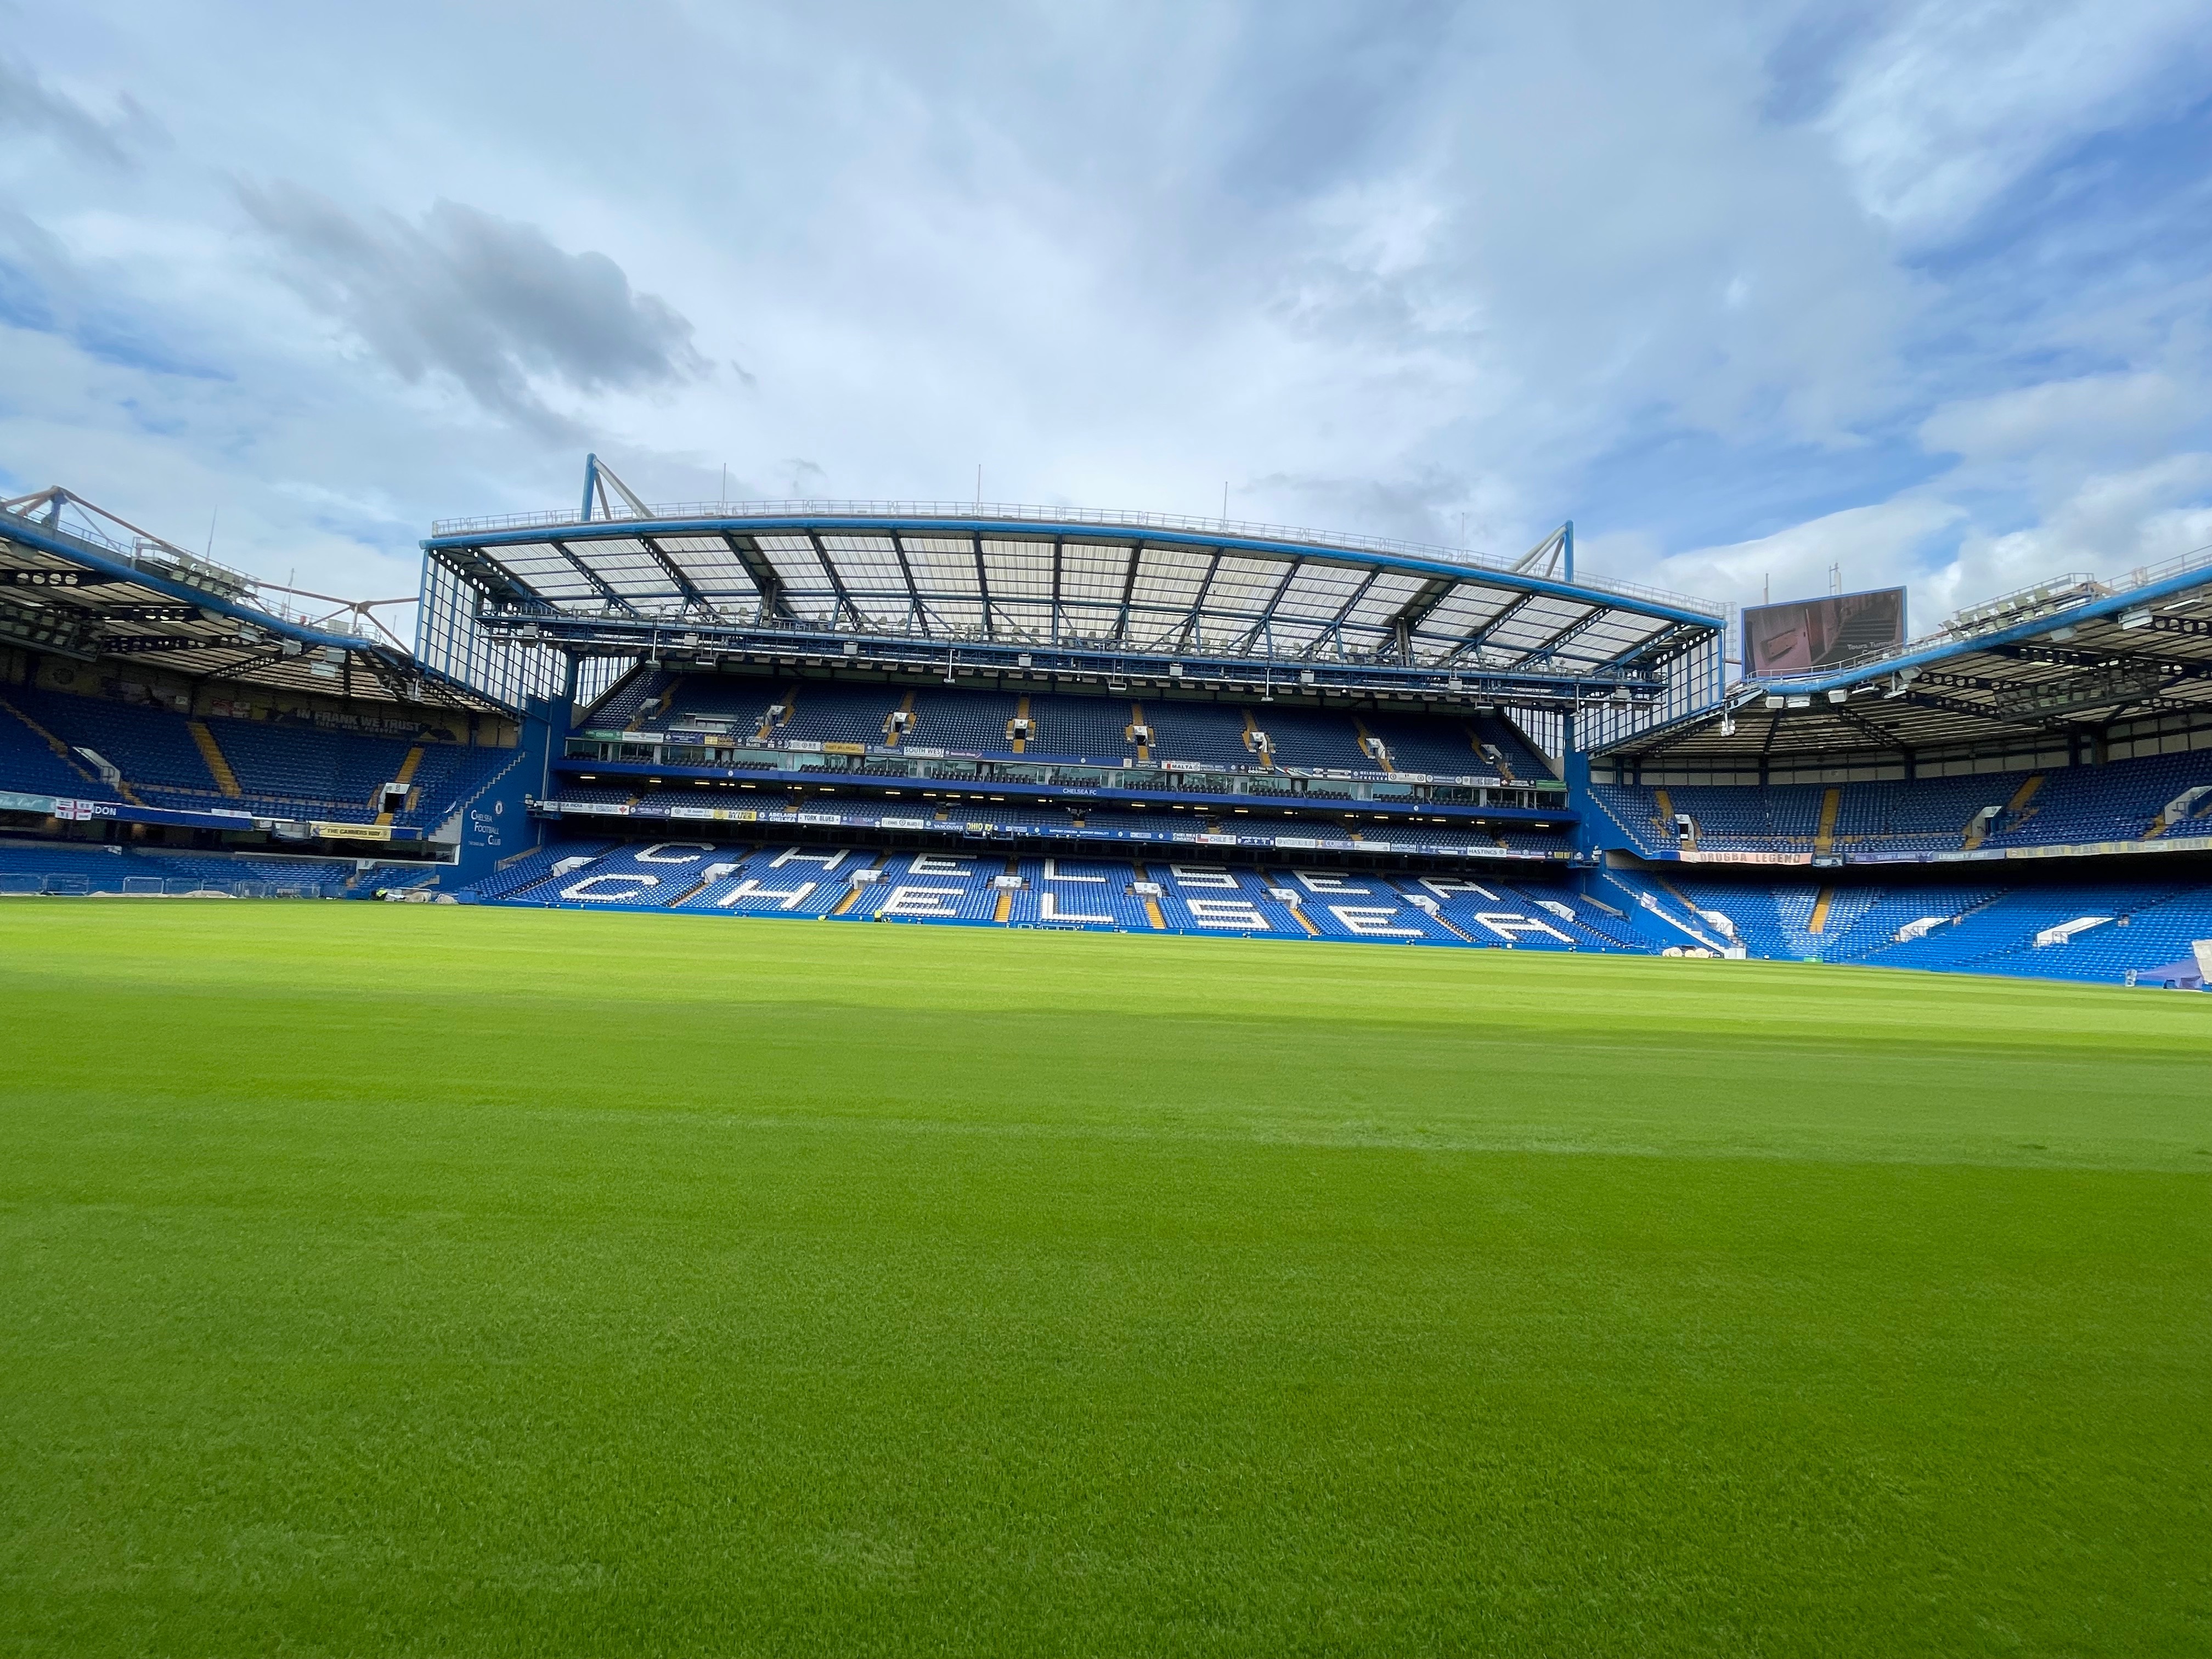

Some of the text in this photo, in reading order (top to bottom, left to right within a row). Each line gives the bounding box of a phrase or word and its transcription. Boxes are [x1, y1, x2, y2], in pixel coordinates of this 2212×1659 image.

[296, 708, 421, 732] IN FRANK WE TRUST
[471, 809, 493, 823] CHELSEA
[474, 821, 499, 835] FOOTBALL
[967, 822, 983, 832] OHIO
[488, 834, 501, 845] CLUB
[1701, 853, 1801, 864] DROGBA LEGEND
